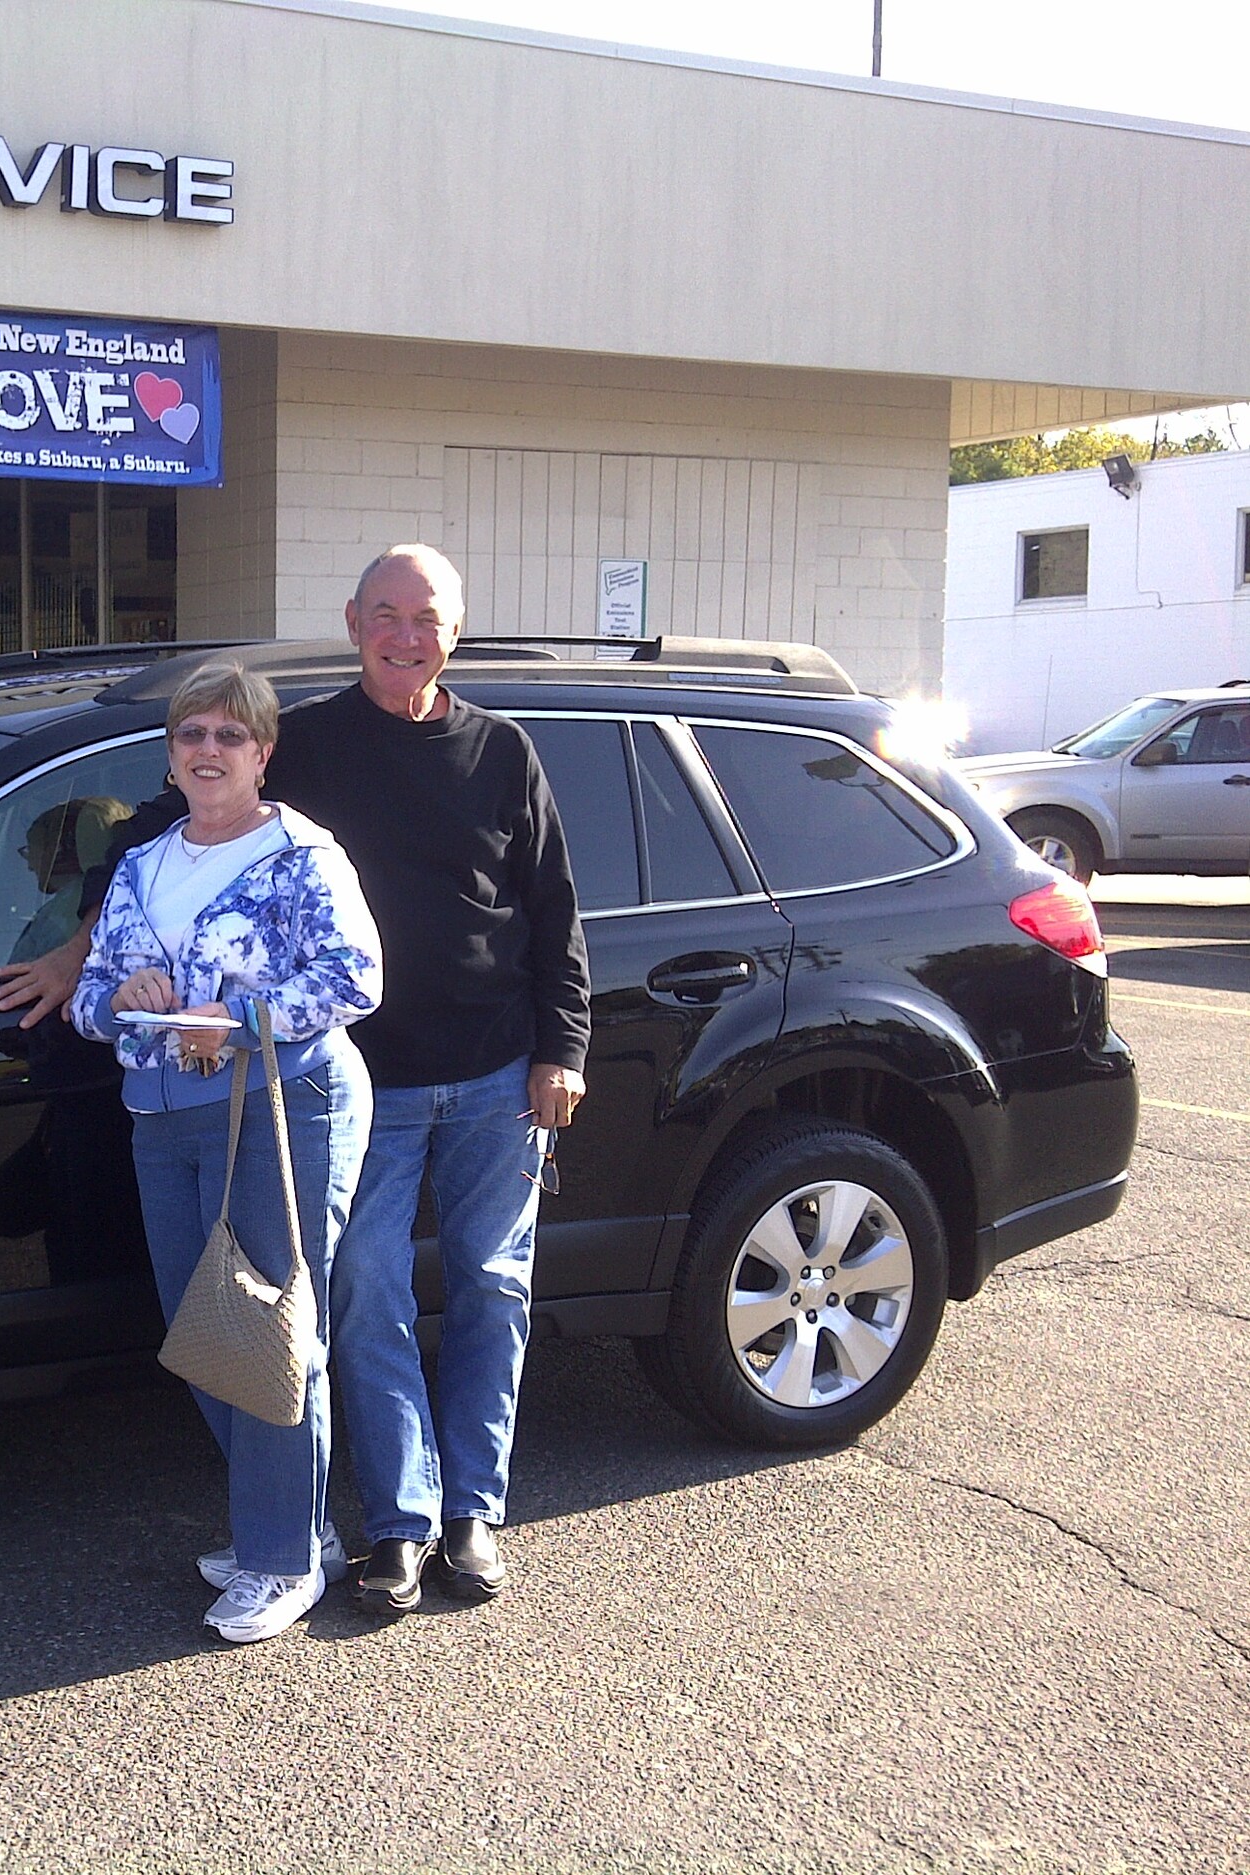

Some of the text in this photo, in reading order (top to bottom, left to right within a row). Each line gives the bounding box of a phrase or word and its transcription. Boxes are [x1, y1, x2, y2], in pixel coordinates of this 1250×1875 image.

[65, 329, 186, 365] England
[24, 454, 37, 466] a
[38, 449, 107, 472] Subaru,
[109, 457, 121, 470] a
[123, 454, 190, 474] Subaru.
